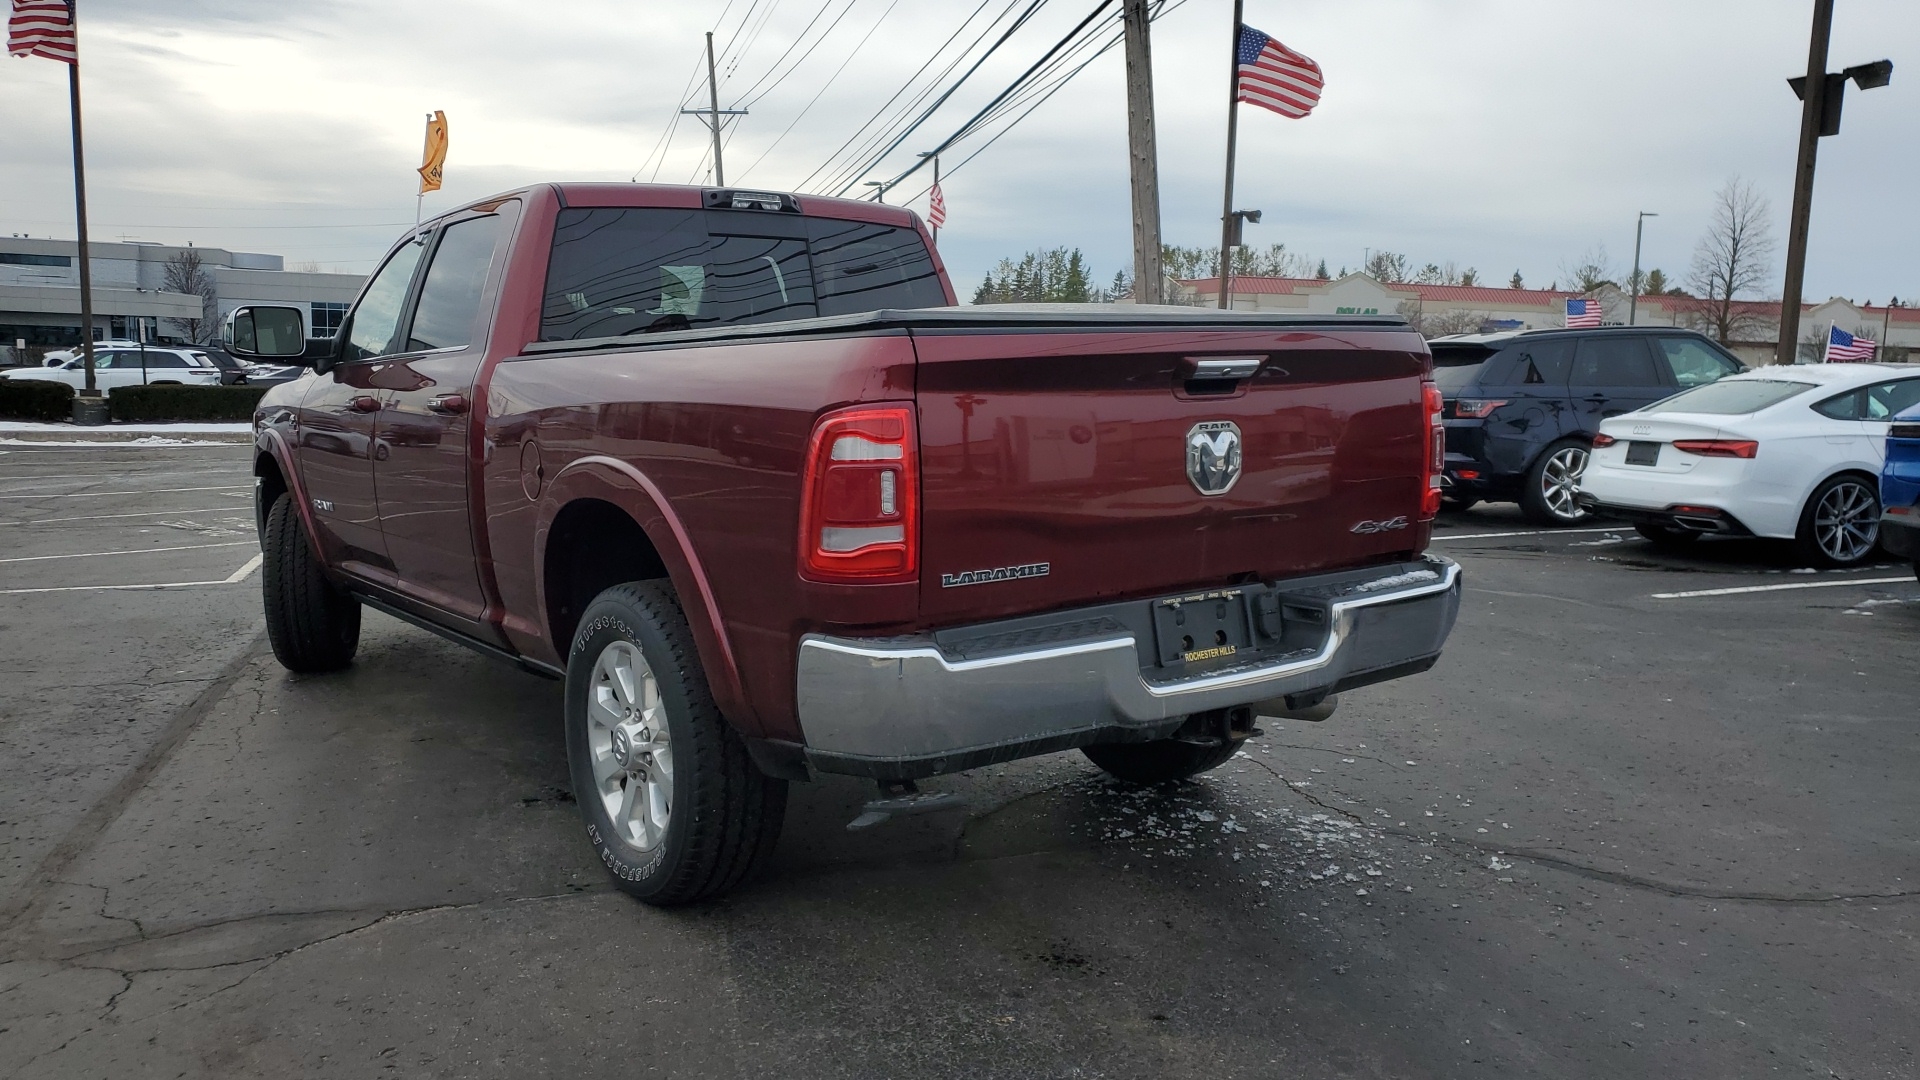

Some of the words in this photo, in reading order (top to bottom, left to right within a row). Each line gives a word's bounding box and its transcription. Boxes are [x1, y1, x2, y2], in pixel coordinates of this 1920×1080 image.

[1198, 422, 1231, 430] RAM
[942, 562, 1050, 588] LARAMIE
[577, 615, 644, 654] Firestone
[1185, 648, 1219, 662] ROCHESTER
[1219, 645, 1236, 656] HILLS
[587, 823, 603, 845] AT
[601, 843, 667, 882] TRANSFORCE
